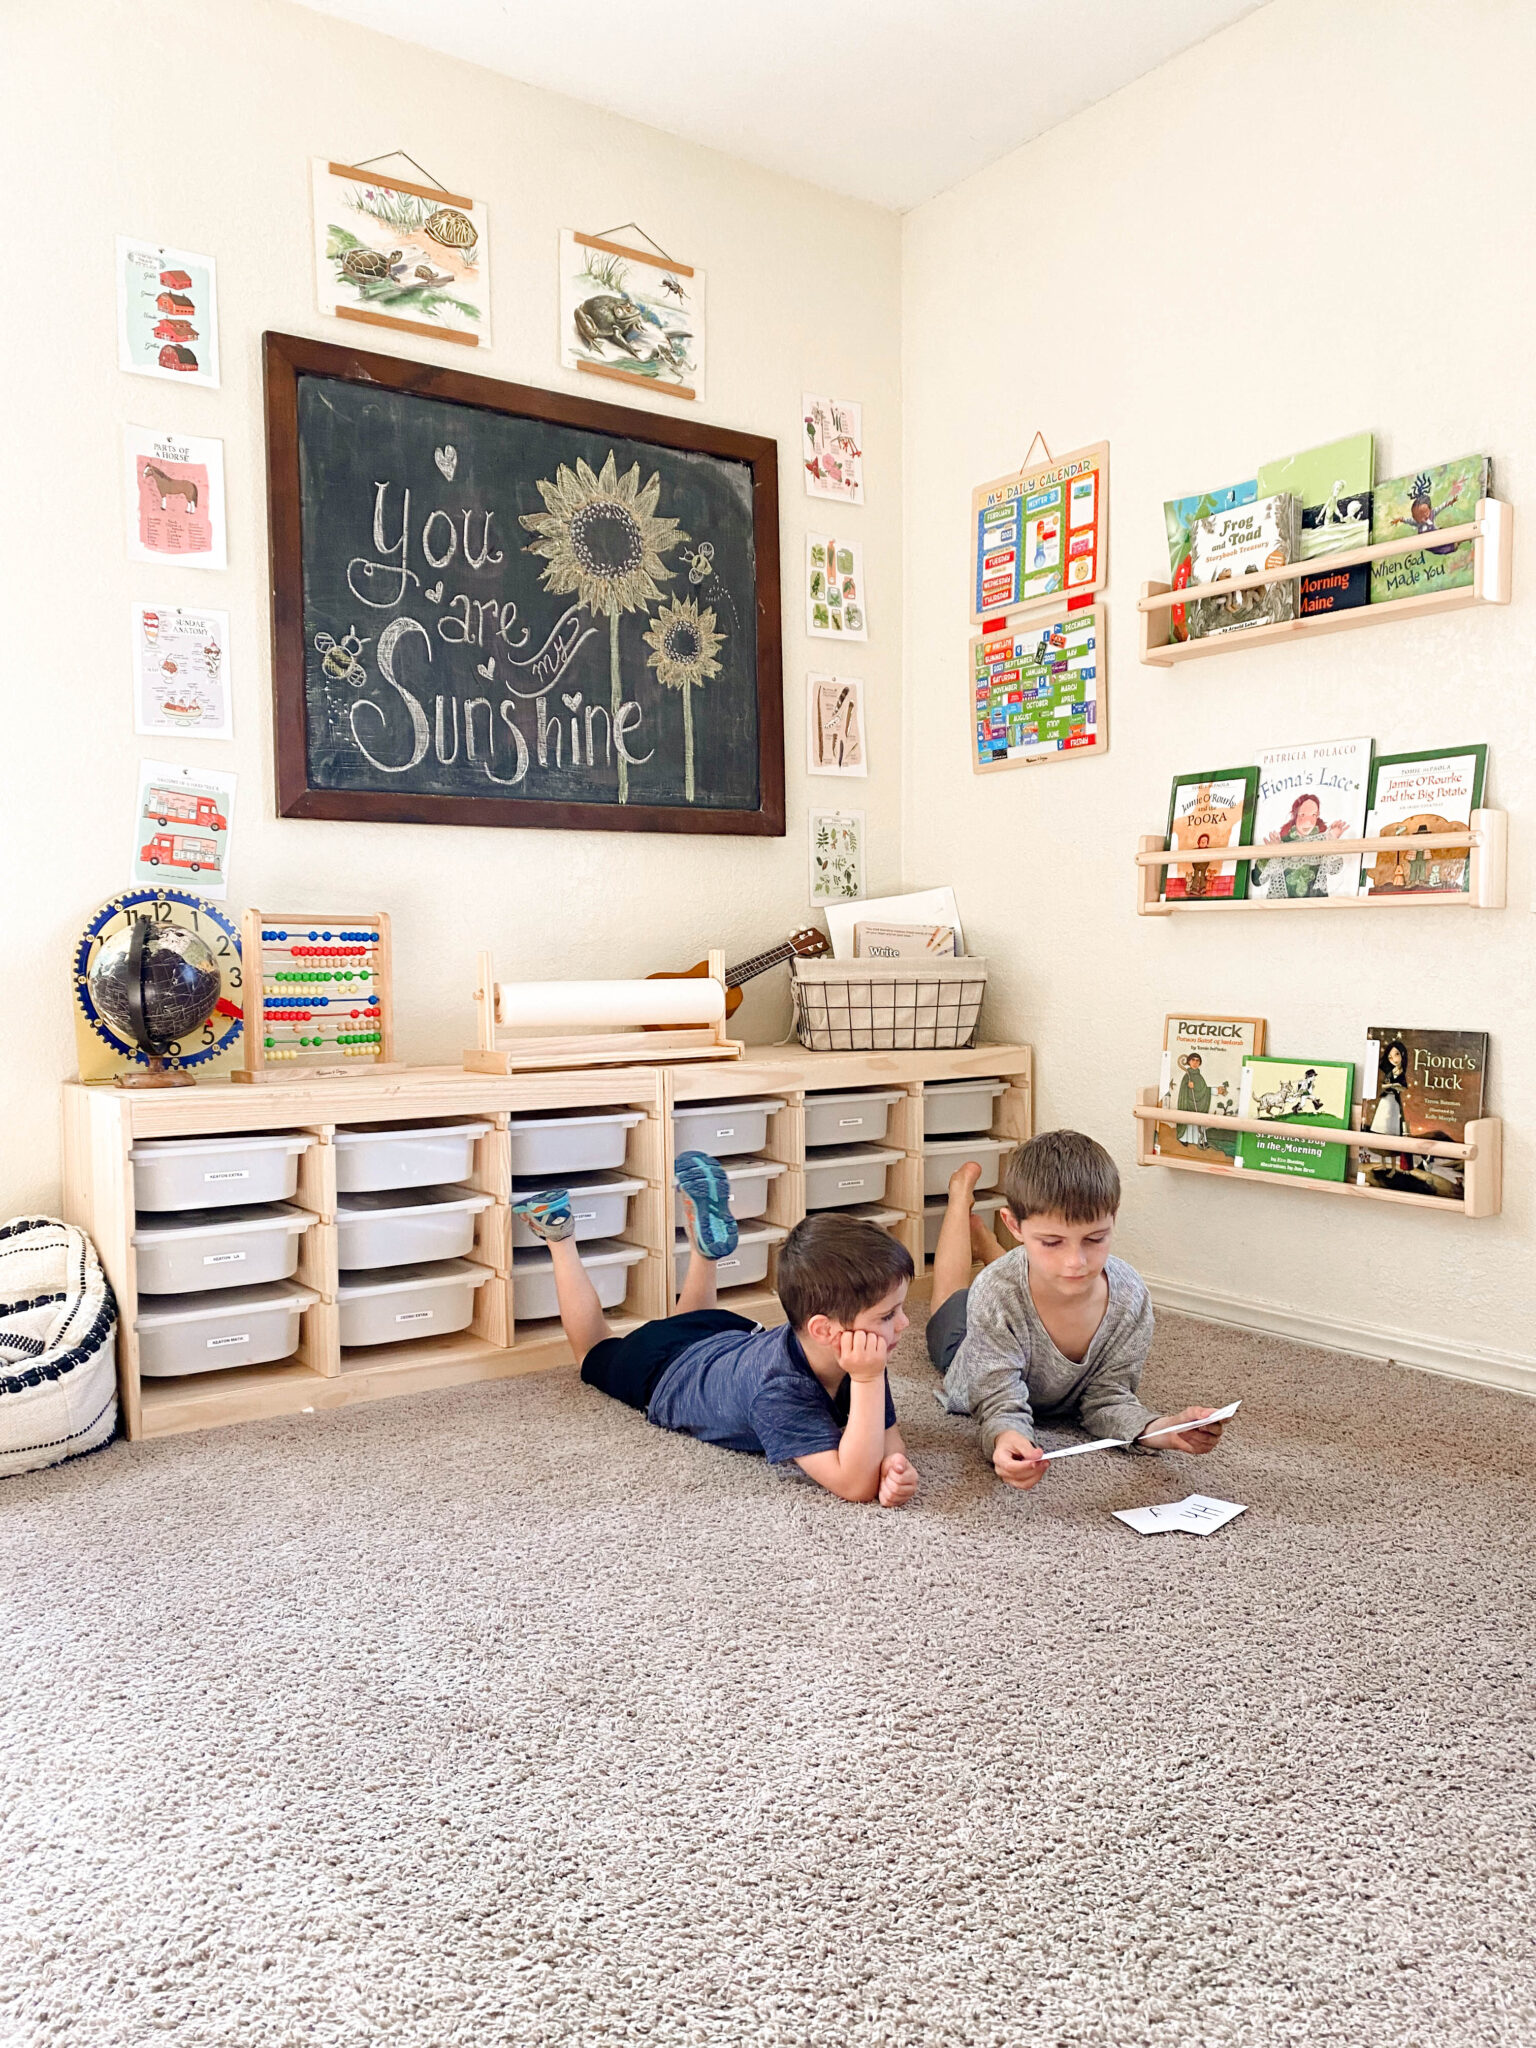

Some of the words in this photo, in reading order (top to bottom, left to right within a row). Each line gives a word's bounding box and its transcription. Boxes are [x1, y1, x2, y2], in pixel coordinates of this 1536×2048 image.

[154, 443, 177, 453] PARTS
[179, 447, 190, 455] OF
[162, 452, 190, 462] HORSE
[987, 491, 1003, 506] MY
[1007, 479, 1035, 498] DAILY
[1040, 460, 1091, 487] CALENDAR
[1219, 516, 1254, 537] Frog
[1212, 541, 1226, 552] and
[1229, 525, 1262, 546] Toad
[989, 554, 1010, 566] TUESDAY
[1206, 549, 1238, 563] Storybook
[1372, 560, 1403, 579] When
[1405, 551, 1426, 570] God
[1387, 570, 1420, 591] Made
[1424, 565, 1445, 581] You
[984, 590, 1009, 604] THURSDAY
[176, 619, 206, 628] SUNDAE
[438, 594, 531, 647] are
[173, 627, 208, 636] ANATOMY
[532, 617, 580, 682] my
[350, 617, 656, 785] Sunshine
[1263, 751, 1306, 764] PATRICIA
[1313, 745, 1356, 758] POLACCO
[1260, 770, 1313, 800] Fiona's
[1316, 766, 1353, 792] Lace
[1387, 779, 1414, 793] Jamie
[1416, 772, 1462, 786] O'Rourke
[1380, 790, 1399, 803] and
[1400, 789, 1415, 801] the
[1418, 789, 1434, 802] Big
[1437, 787, 1467, 797] Potato
[1187, 812, 1227, 827] POOKA
[124, 910, 139, 926] 11
[152, 902, 173, 922] 12
[191, 911, 199, 931] 1
[216, 936, 231, 956] 2
[869, 946, 900, 957] Write
[229, 967, 243, 988] 3
[202, 1025, 215, 1045] 5
[1414, 1048, 1476, 1070] Fiona's
[1424, 1070, 1463, 1090] Luck
[1257, 1140, 1265, 1149] in
[1267, 1141, 1281, 1151] the
[1281, 1143, 1323, 1158] Morning
